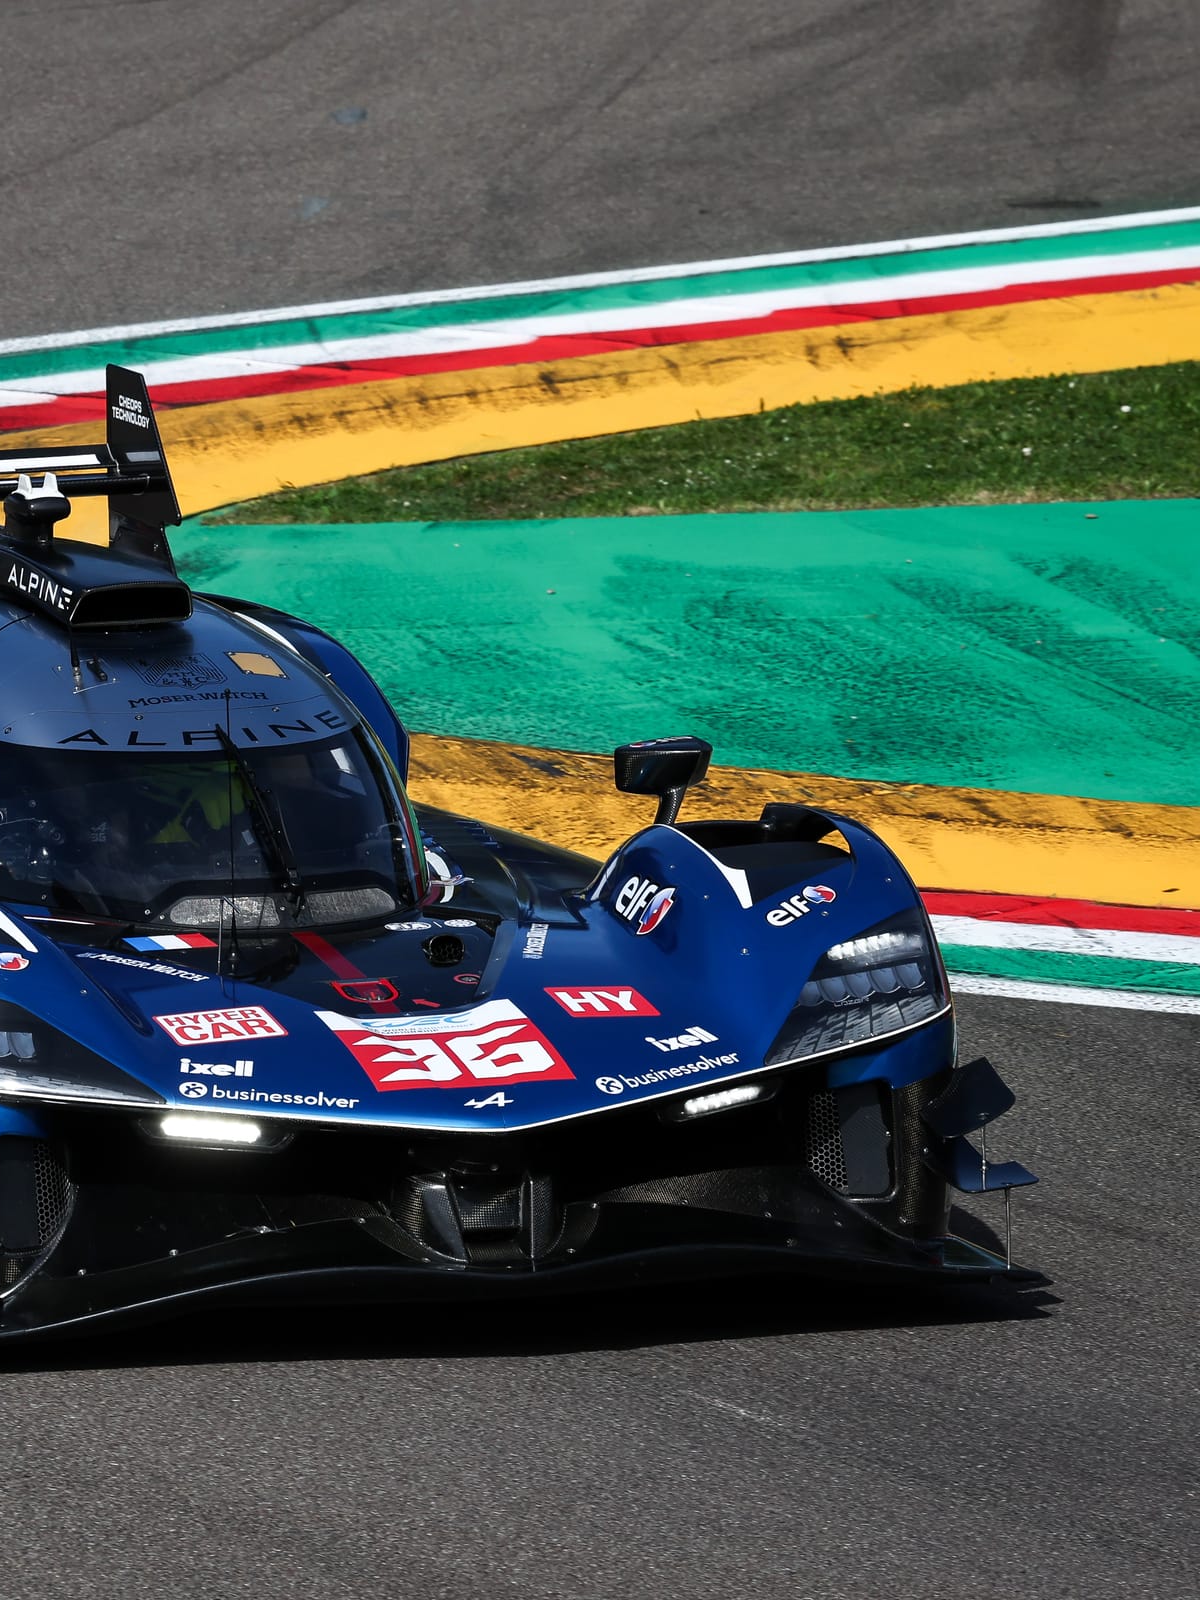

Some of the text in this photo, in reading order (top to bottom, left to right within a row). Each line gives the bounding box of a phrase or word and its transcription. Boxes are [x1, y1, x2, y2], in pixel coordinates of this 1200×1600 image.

[118, 395, 142, 413] CHEOPS
[112, 406, 150, 429] TECHNOLOGY
[8, 564, 73, 610] ALPINE
[128, 691, 270, 709] MOSER WATCH
[57, 710, 347, 746] ALPINE
[615, 876, 658, 923] elf
[766, 893, 810, 927] elf
[554, 991, 641, 1013] HY
[163, 1008, 260, 1027] HYPER
[175, 1019, 275, 1041] CAR
[644, 1026, 719, 1053] ixell
[352, 1024, 555, 1082] 36
[180, 1058, 253, 1077] ixell
[623, 1050, 739, 1089] businessolver
[212, 1085, 359, 1108] businessolver
